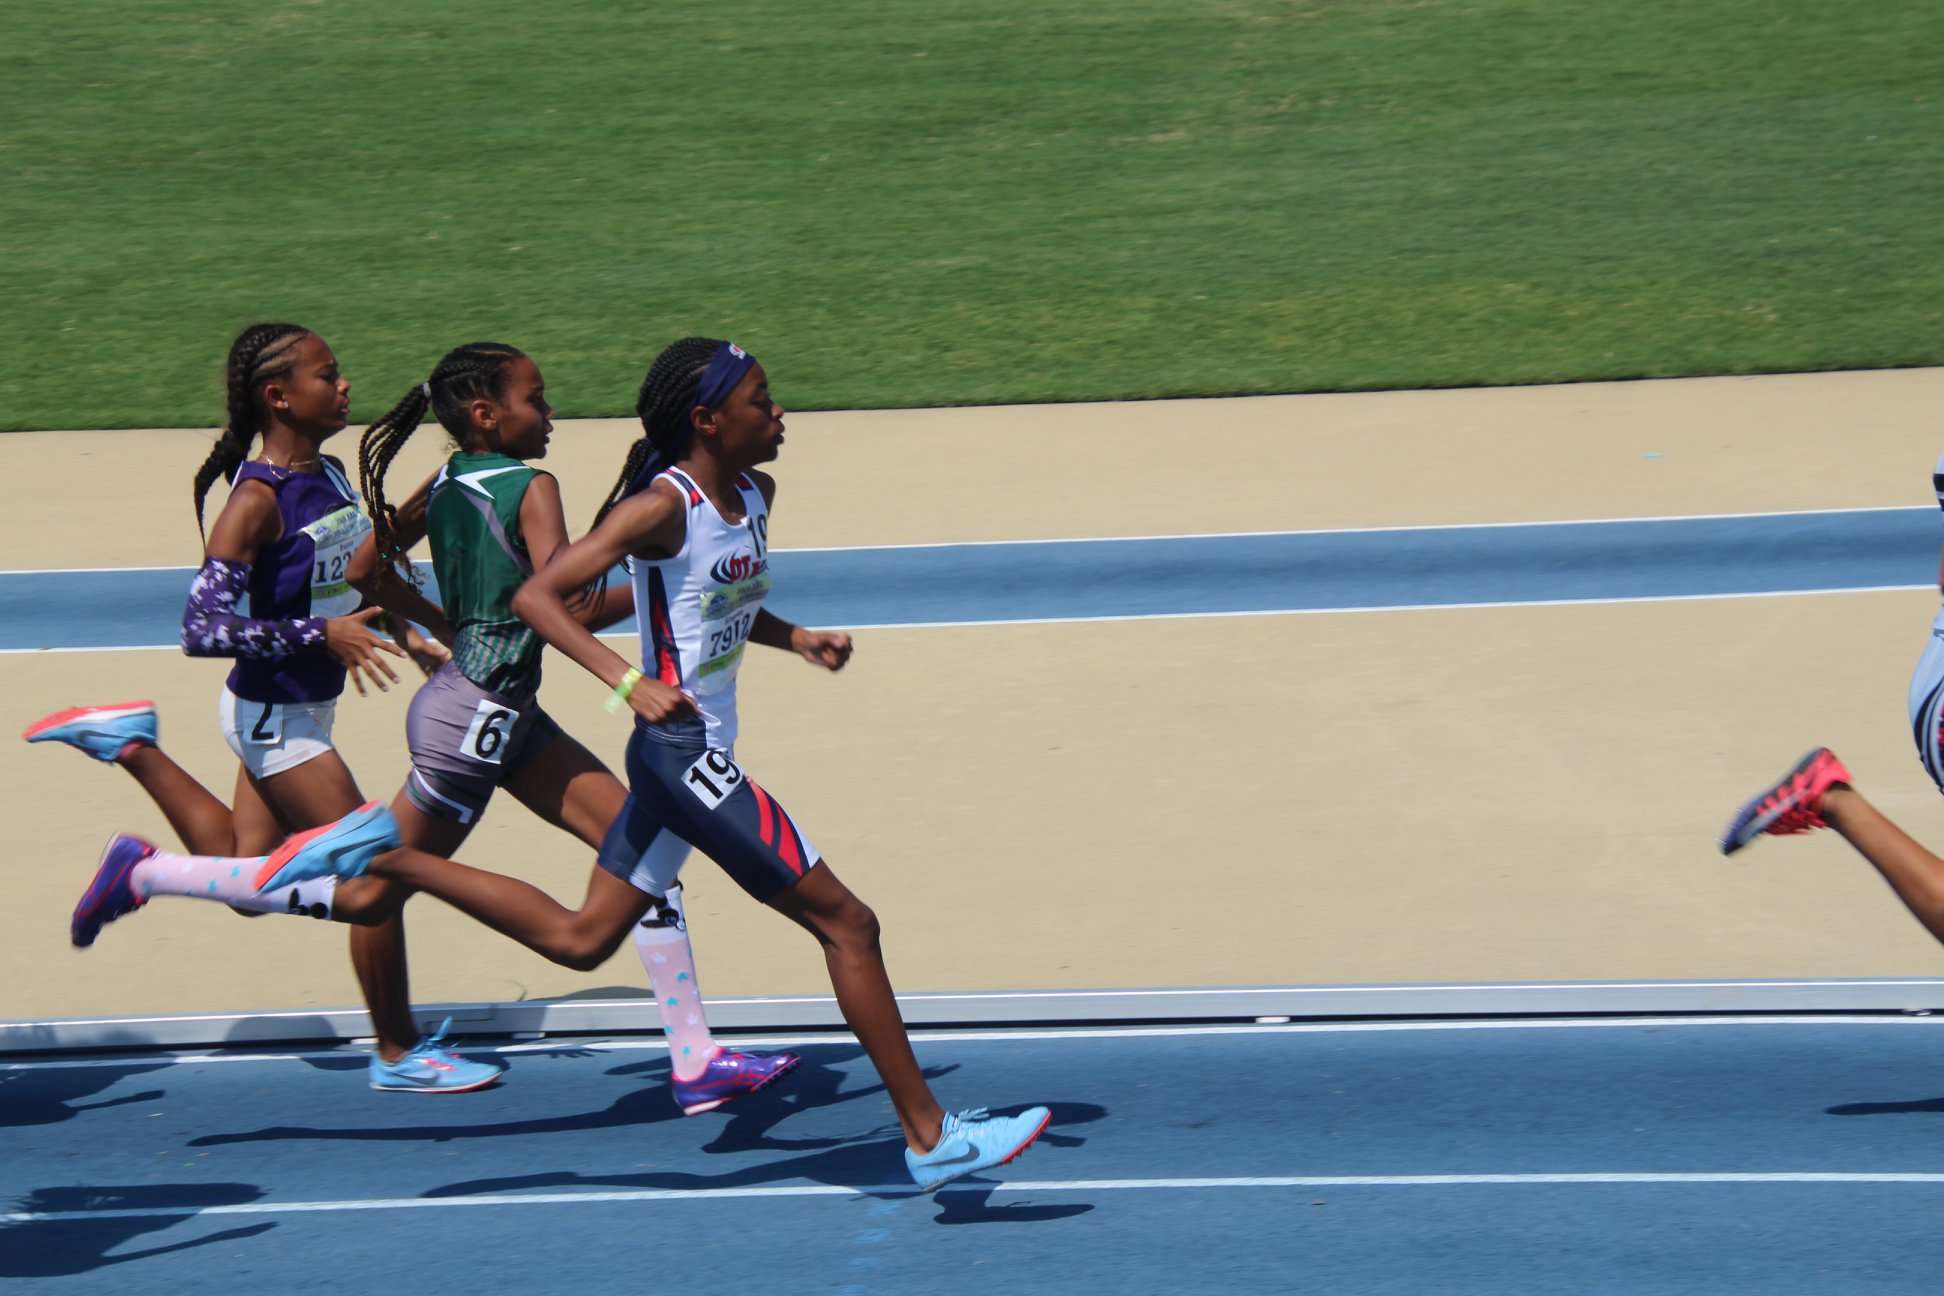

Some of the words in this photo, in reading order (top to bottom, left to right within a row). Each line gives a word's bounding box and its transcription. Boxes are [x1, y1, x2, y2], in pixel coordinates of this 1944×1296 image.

[709, 613, 750, 658] 7912
[251, 703, 274, 740] 2
[475, 710, 510, 758] 6
[689, 749, 740, 800] 19
